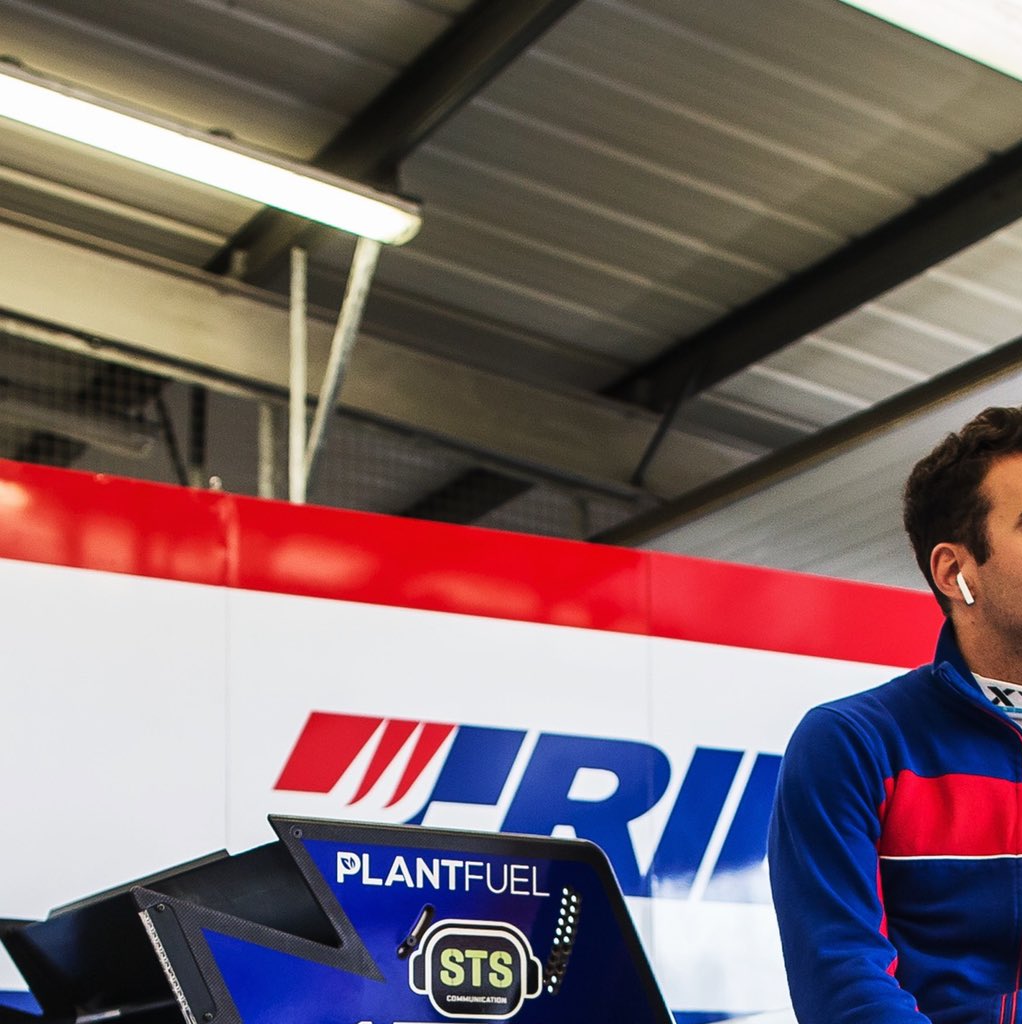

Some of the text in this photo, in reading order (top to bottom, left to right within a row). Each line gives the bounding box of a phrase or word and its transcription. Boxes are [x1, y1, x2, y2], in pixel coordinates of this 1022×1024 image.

[273, 711, 784, 898] TRI
[337, 851, 550, 897] PLANTFUEL
[440, 948, 513, 988] STS
[446, 994, 507, 1004] COMMUNICATION
